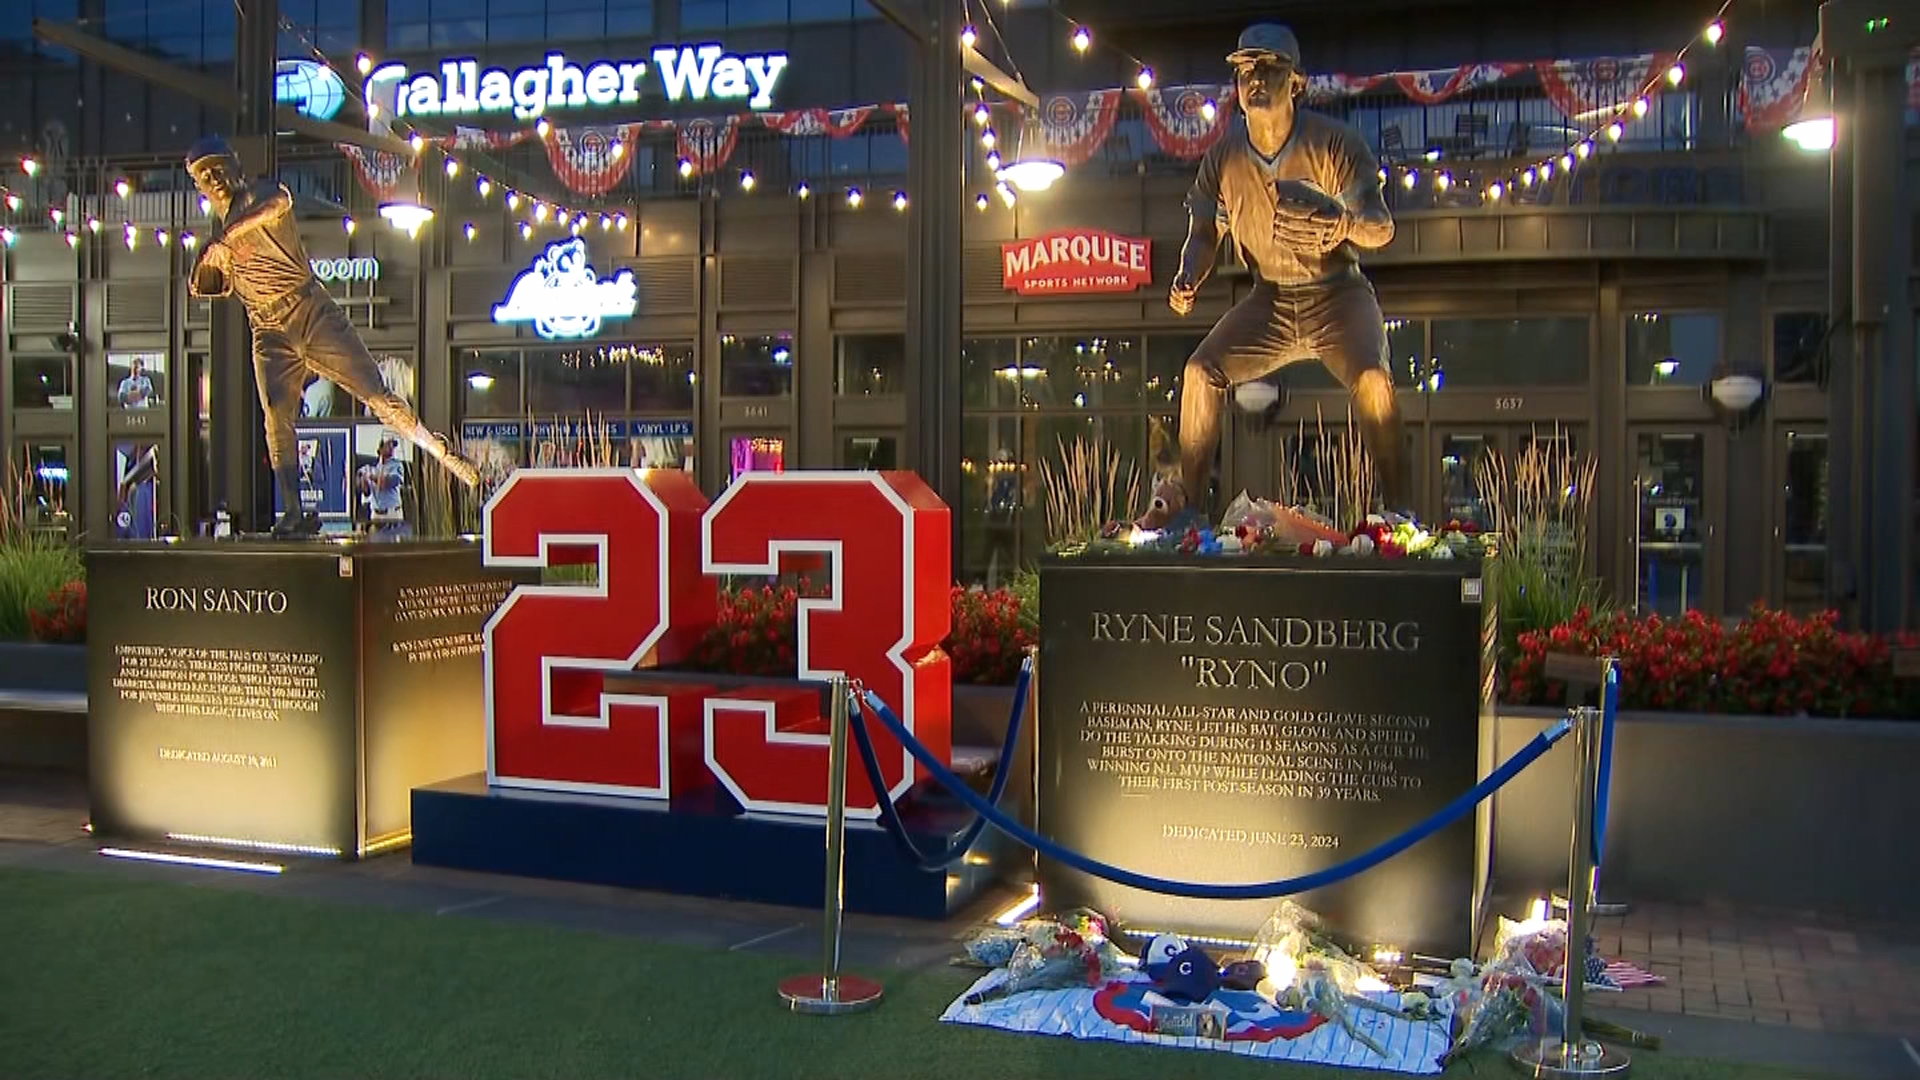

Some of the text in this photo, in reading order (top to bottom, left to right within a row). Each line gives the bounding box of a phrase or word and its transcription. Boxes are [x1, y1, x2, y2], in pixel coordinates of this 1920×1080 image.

[364, 45, 788, 120] Gallagher Way
[1006, 236, 1146, 277] MARQUEE
[1024, 275, 1128, 289] SPORTS NETWORK
[495, 424, 518, 435] USED
[637, 424, 663, 434] VINYL
[146, 586, 288, 614] RON SANTO
[483, 468, 914, 819] 23
[1091, 611, 1420, 652] RYNE SANDBERG
[1180, 655, 1328, 692] "RYNO"
[1080, 701, 1430, 729] A PERENNIAL ALL-STAR AND GOLD GLOVE SECOND
[1080, 730, 1101, 742] DO
[1104, 731, 1132, 744] THE
[1135, 733, 1197, 747] TALKING
[1200, 736, 1255, 750] DURING
[1275, 740, 1337, 754] SEASONS
[1341, 742, 1358, 755] AS
[1361, 745, 1370, 756] A
[1156, 718, 1194, 732] RYNE
[1197, 721, 1223, 733] LET
[1225, 722, 1248, 735] HIS
[1281, 726, 1331, 739] GLOVE
[1335, 728, 1367, 741] AND
[1369, 730, 1416, 744] SPEED
[1102, 745, 1143, 759] BURST
[1146, 748, 1187, 762] ONTO
[1190, 750, 1219, 764] THE
[1221, 752, 1296, 768] NATIONAL
[1298, 756, 1344, 770] SCENE
[1348, 758, 1363, 771] IN
[1087, 758, 1151, 774] WINNING
[1180, 764, 1210, 778] MVP
[1213, 766, 1259, 780] WHILE
[1262, 769, 1326, 784] LEADING
[1329, 773, 1358, 786] THE
[1362, 774, 1398, 788] CUBS
[1401, 777, 1422, 790] TO
[1119, 774, 1160, 789] THEIR
[1163, 778, 1199, 792] FIRST
[1298, 786, 1313, 798] IN
[1317, 787, 1332, 799] 39
[1163, 824, 1248, 843] DEDICATED
[1248, 831, 1287, 846] JUNE
[1311, 836, 1340, 850] 2024
[1179, 962, 1192, 975] C
